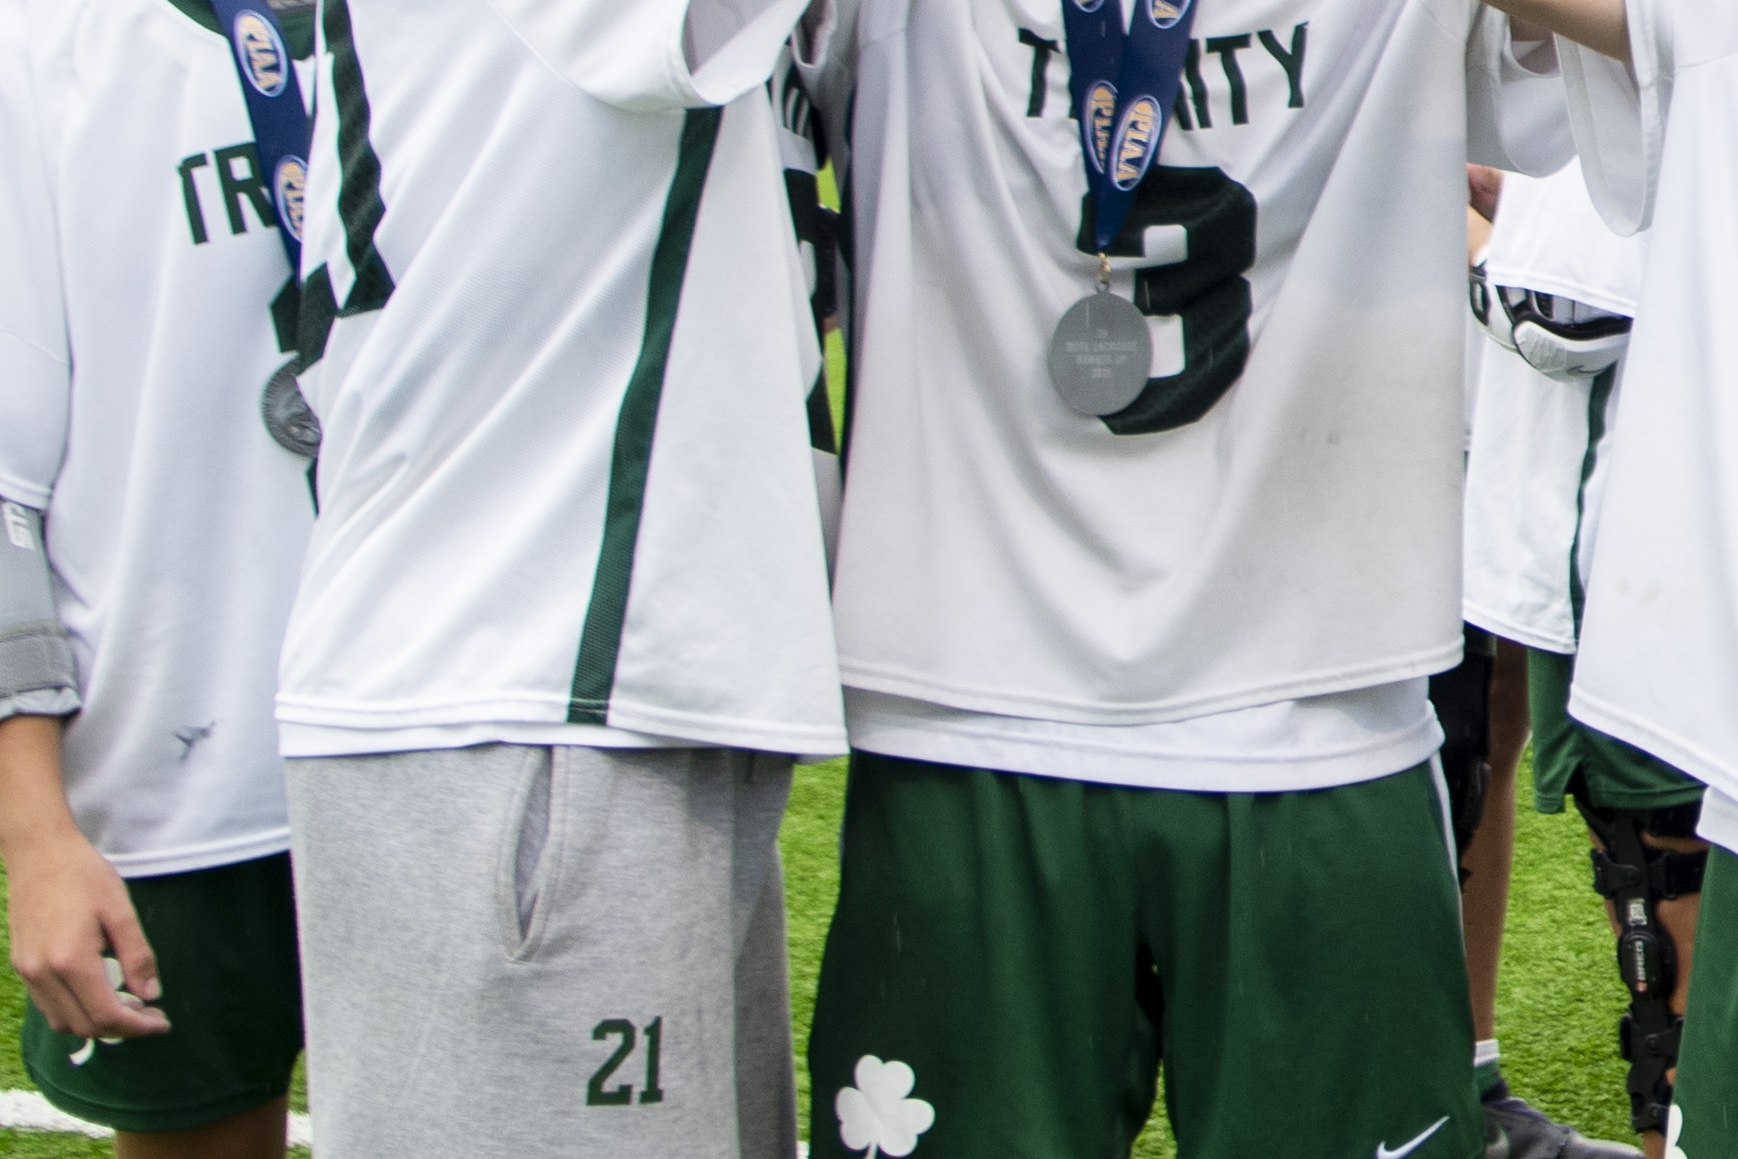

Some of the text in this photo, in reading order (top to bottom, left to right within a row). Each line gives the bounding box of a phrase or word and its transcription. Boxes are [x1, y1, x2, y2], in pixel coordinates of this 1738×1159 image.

[239, 14, 285, 93] PIAA
[1115, 99, 1155, 181] PIAA
[1076, 165, 1257, 436] 3
[585, 1016, 664, 1107] 21
